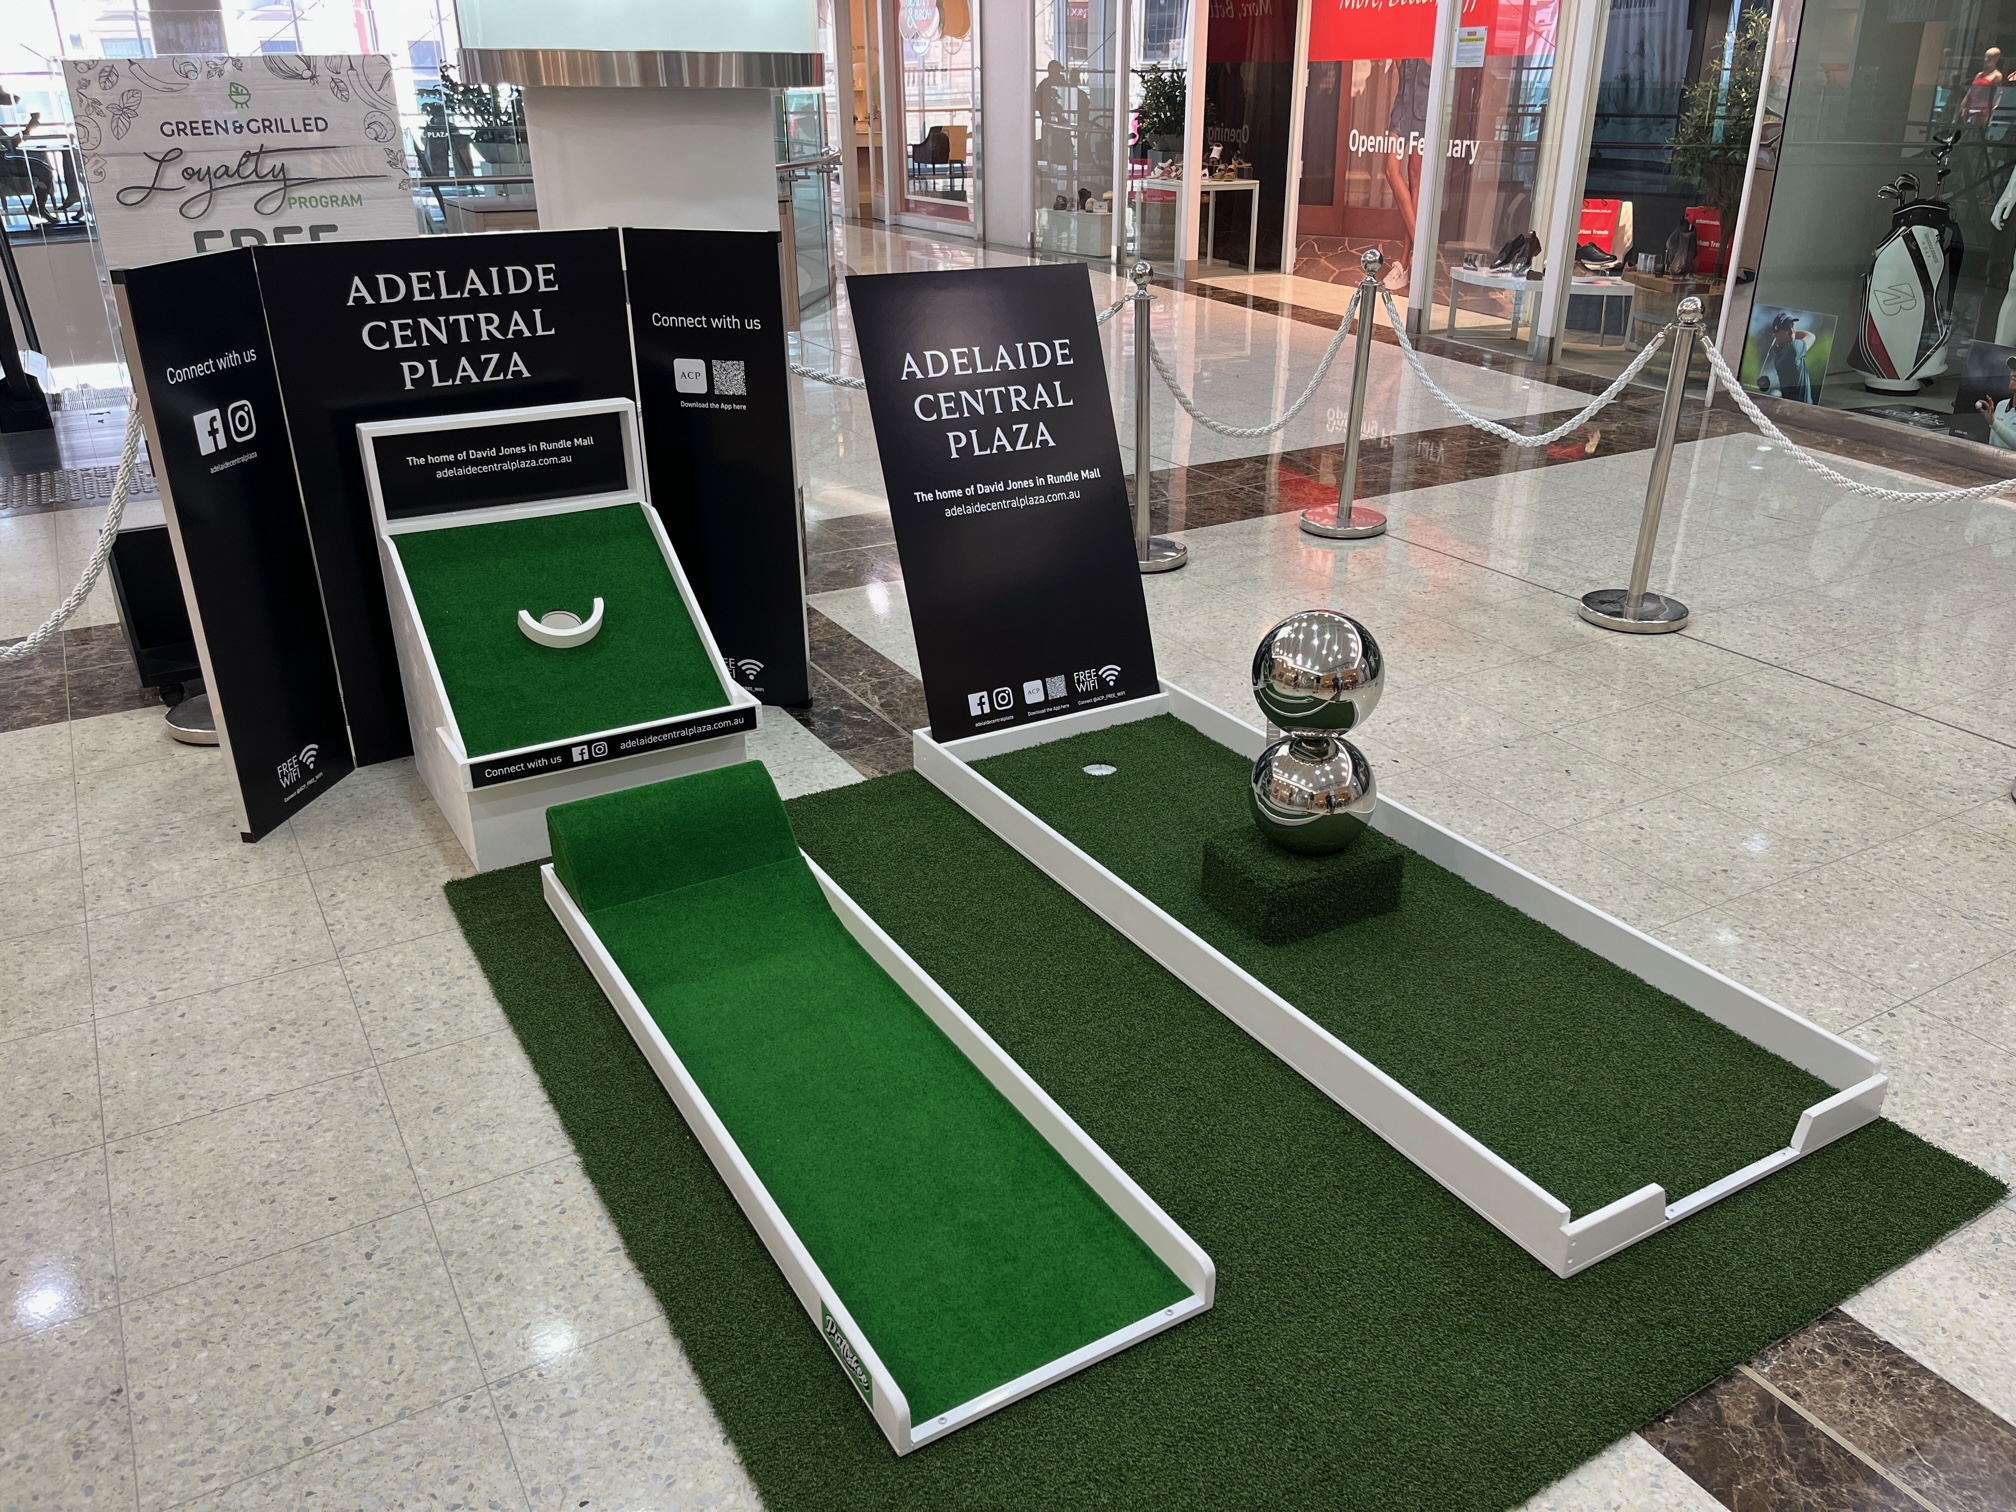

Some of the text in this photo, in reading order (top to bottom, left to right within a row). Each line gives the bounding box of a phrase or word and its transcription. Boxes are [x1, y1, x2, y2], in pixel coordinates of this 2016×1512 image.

[1349, 129, 1405, 160] Opening
[287, 194, 363, 210] PROGRAM
[347, 263, 559, 306] ADELAIDE
[361, 308, 556, 351] CENTRAL
[652, 312, 762, 330] Connect with us
[166, 348, 257, 385] Connect with us
[400, 351, 532, 390] PLAZA
[900, 338, 1074, 381] ADELAIDE
[680, 371, 701, 380] ACP
[680, 401, 709, 409] Download
[720, 403, 732, 411] App
[733, 403, 747, 411] here
[914, 380, 1074, 422] CENTRAL
[406, 436, 594, 467] The home of David Jones in Rundle Mall
[946, 421, 1056, 459] PLAZA
[210, 451, 258, 474] adelaidecentralplaza
[436, 454, 572, 479] adelaidecentralplaza.com.au
[914, 468, 1101, 503] The home of David Jones in Rundle Mall
[944, 489, 1080, 517] adelaidecentralplaza.com.au
[1073, 668, 1097, 684] FREE
[1075, 679, 1098, 694] WIFI
[1027, 708, 1046, 717] Download
[484, 717, 744, 779] Connect with us adelaidecentralplaza.com.au
[277, 755, 299, 779] FREE
[280, 767, 301, 789] WIFI
